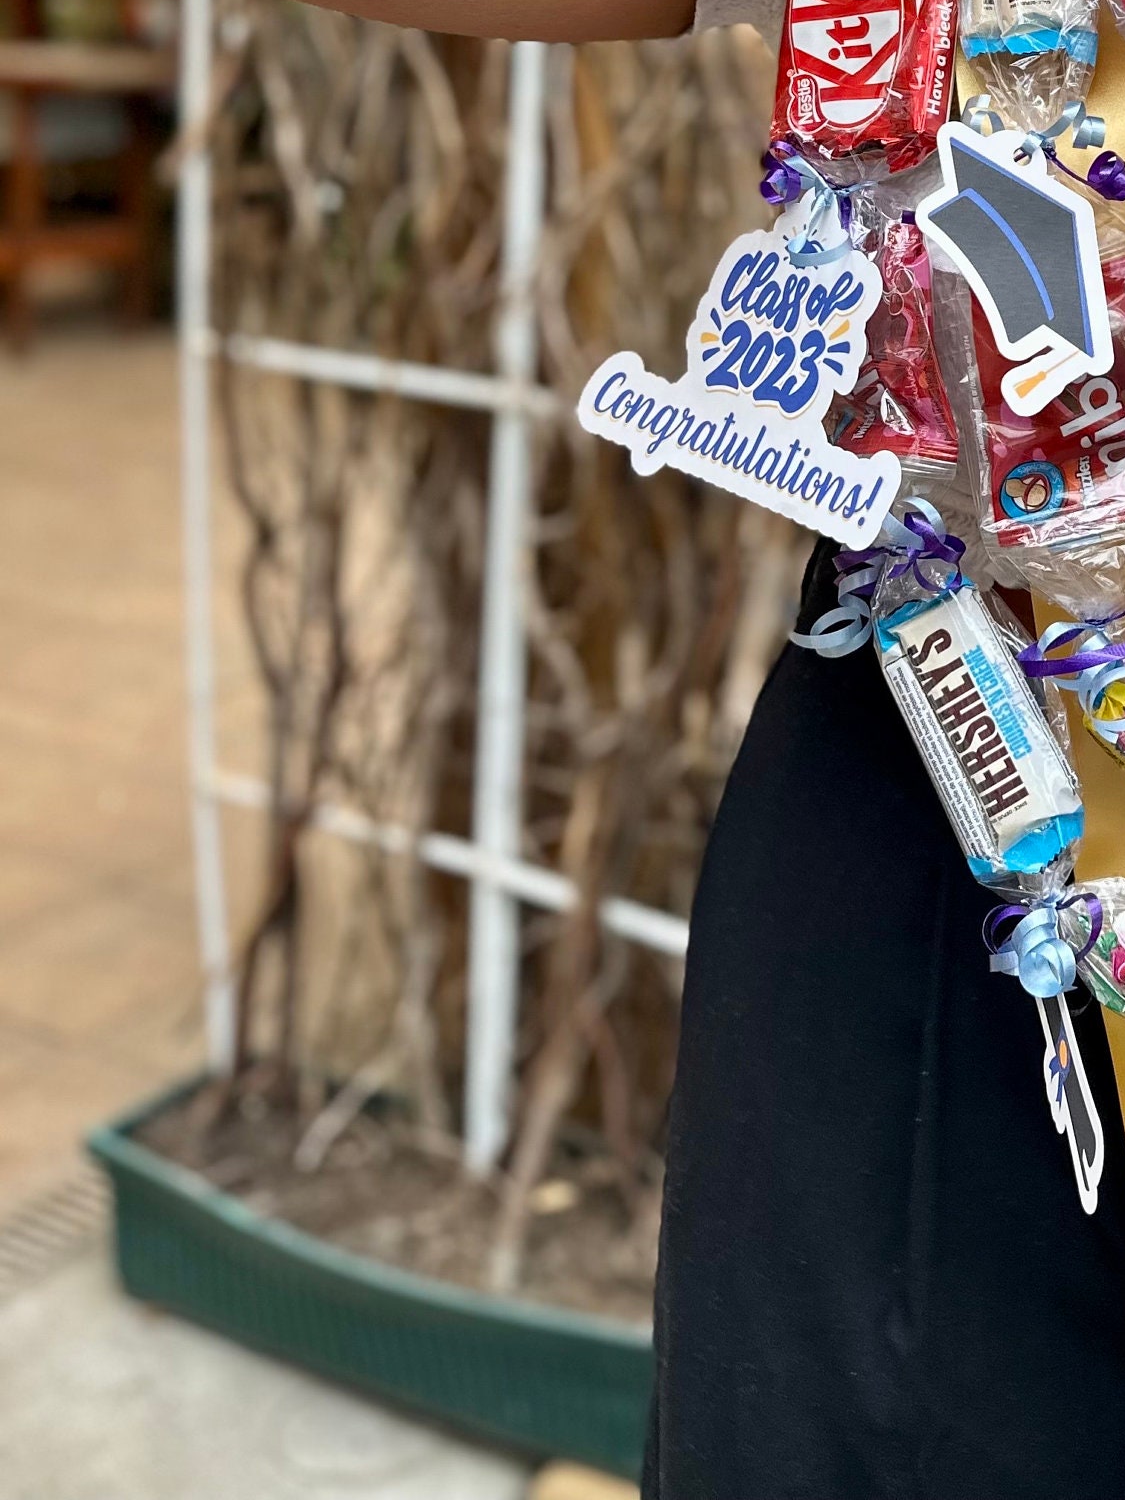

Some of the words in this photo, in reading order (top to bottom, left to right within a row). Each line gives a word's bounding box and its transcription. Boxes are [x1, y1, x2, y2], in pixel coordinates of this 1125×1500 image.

[926, 68, 945, 114] Have
[935, 54, 947, 66] a
[721, 250, 809, 334] Class
[806, 270, 864, 326] of
[705, 320, 826, 414] 2023
[593, 371, 883, 526] Congratulations!
[906, 627, 1029, 818] HERSHEY'S
[990, 701, 1033, 760] COOKIES
